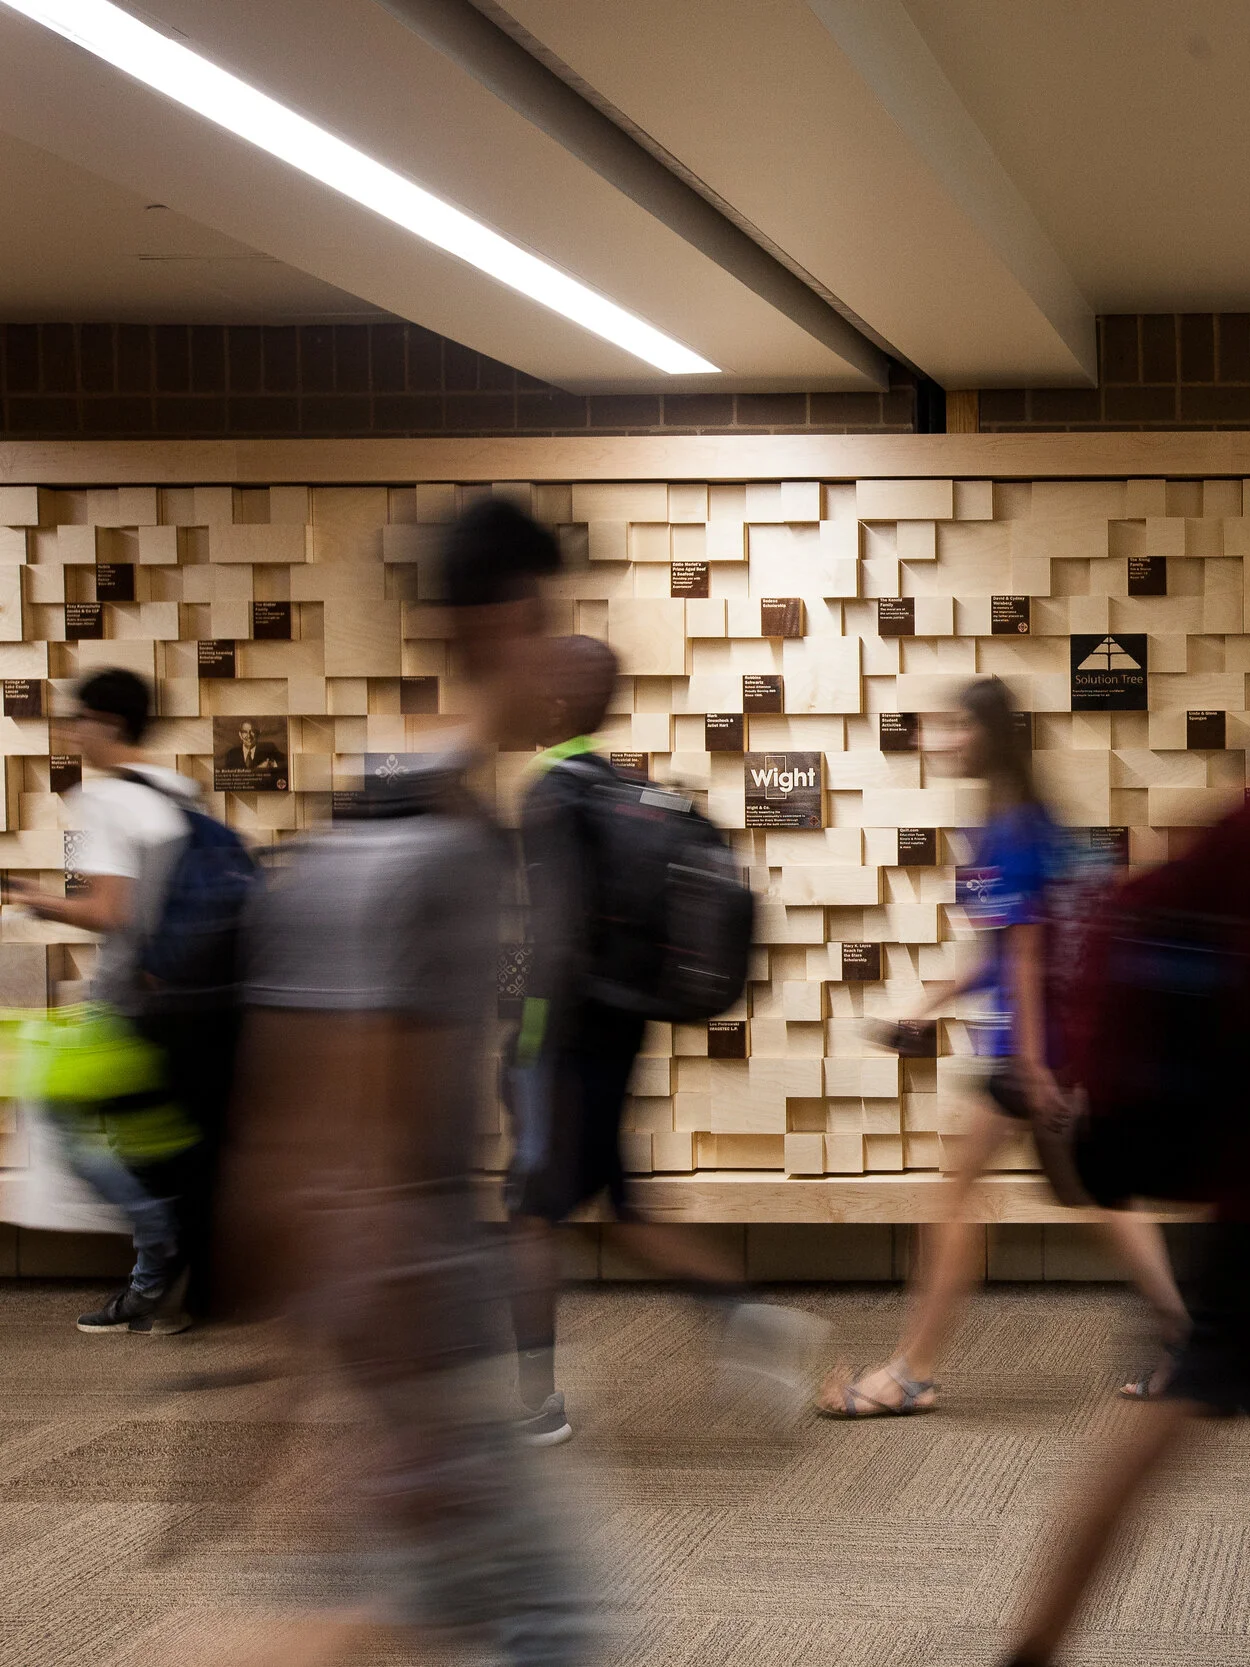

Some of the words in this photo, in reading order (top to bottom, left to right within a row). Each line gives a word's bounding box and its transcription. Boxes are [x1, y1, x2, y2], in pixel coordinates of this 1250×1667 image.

[1076, 674, 1118, 684] Solution
[1121, 674, 1144, 684] Tree
[751, 768, 816, 792] Wight
